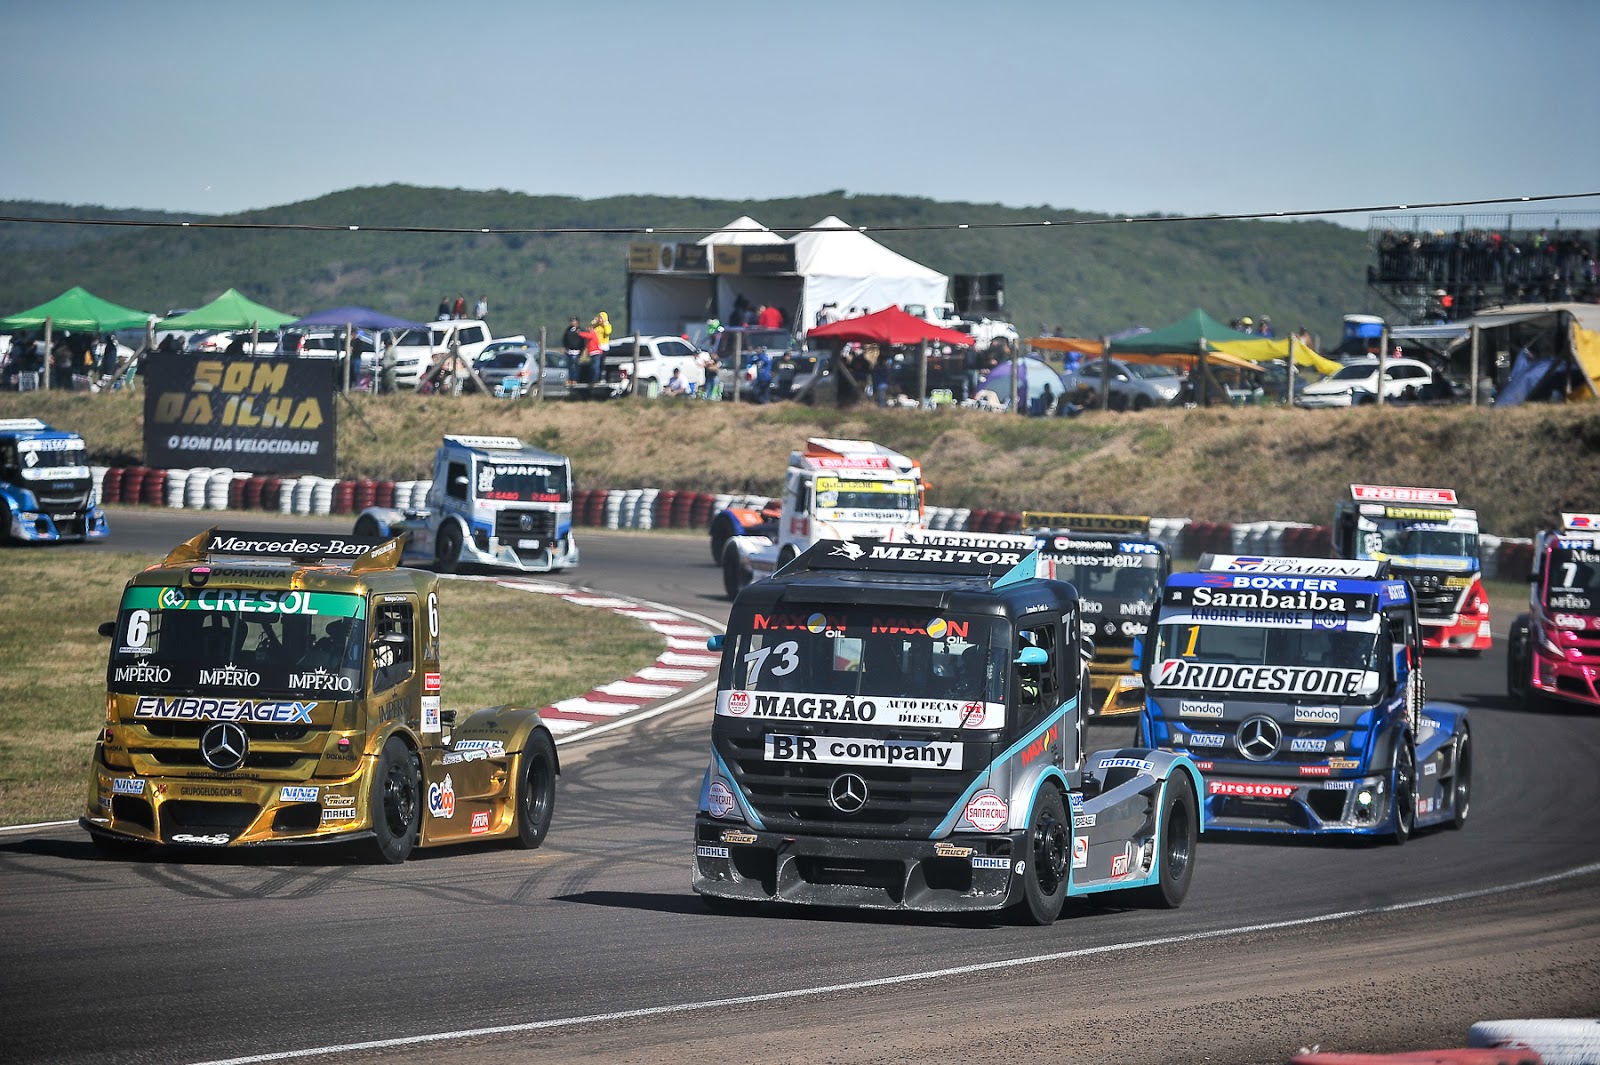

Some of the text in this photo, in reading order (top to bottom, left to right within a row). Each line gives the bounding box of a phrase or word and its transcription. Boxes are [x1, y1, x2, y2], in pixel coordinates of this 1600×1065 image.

[192, 361, 288, 394] SOM
[155, 393, 323, 429] DA ILHA
[168, 436, 319, 455] O SOM DA VELOCIDADE
[1028, 515, 1144, 529] MERITOR
[921, 536, 1026, 549] MERITOR
[1559, 540, 1592, 550] YPF
[868, 546, 1020, 566] MERITOR
[212, 568, 286, 578] DOPAMINA
[1262, 564, 1361, 575] TOMBINI
[1233, 577, 1338, 591] BOXTER
[198, 589, 319, 615] CRESOL
[1192, 587, 1346, 611] Sambaiba
[428, 592, 439, 638] 6
[1191, 608, 1304, 625] KNORR-BREMSE
[126, 610, 150, 647] 6
[825, 630, 846, 638] OIL
[946, 636, 968, 644] OIL
[1182, 625, 1200, 657] 1
[744, 640, 800, 686] 73
[1160, 660, 1363, 694] BRIDGESTONE
[135, 696, 318, 724] EMBREAGEX
[753, 694, 877, 722] MAGRÃO
[886, 700, 959, 714] AUTO PEÇAS
[1181, 702, 1223, 717] bandag
[1296, 707, 1339, 723] bandag
[773, 735, 952, 767] BR company
[1292, 739, 1326, 750] NINO
[1100, 760, 1153, 770] MAHLE
[113, 779, 144, 791] NINO
[181, 787, 243, 797] GRUPOGELOG.COM.BR
[1211, 782, 1292, 796] Firestone
[282, 787, 317, 798] NINO
[430, 786, 454, 815] Gelog
[323, 809, 356, 818] MAHLE
[698, 846, 727, 856] MAHLE
[973, 858, 1008, 868] MAHLE
